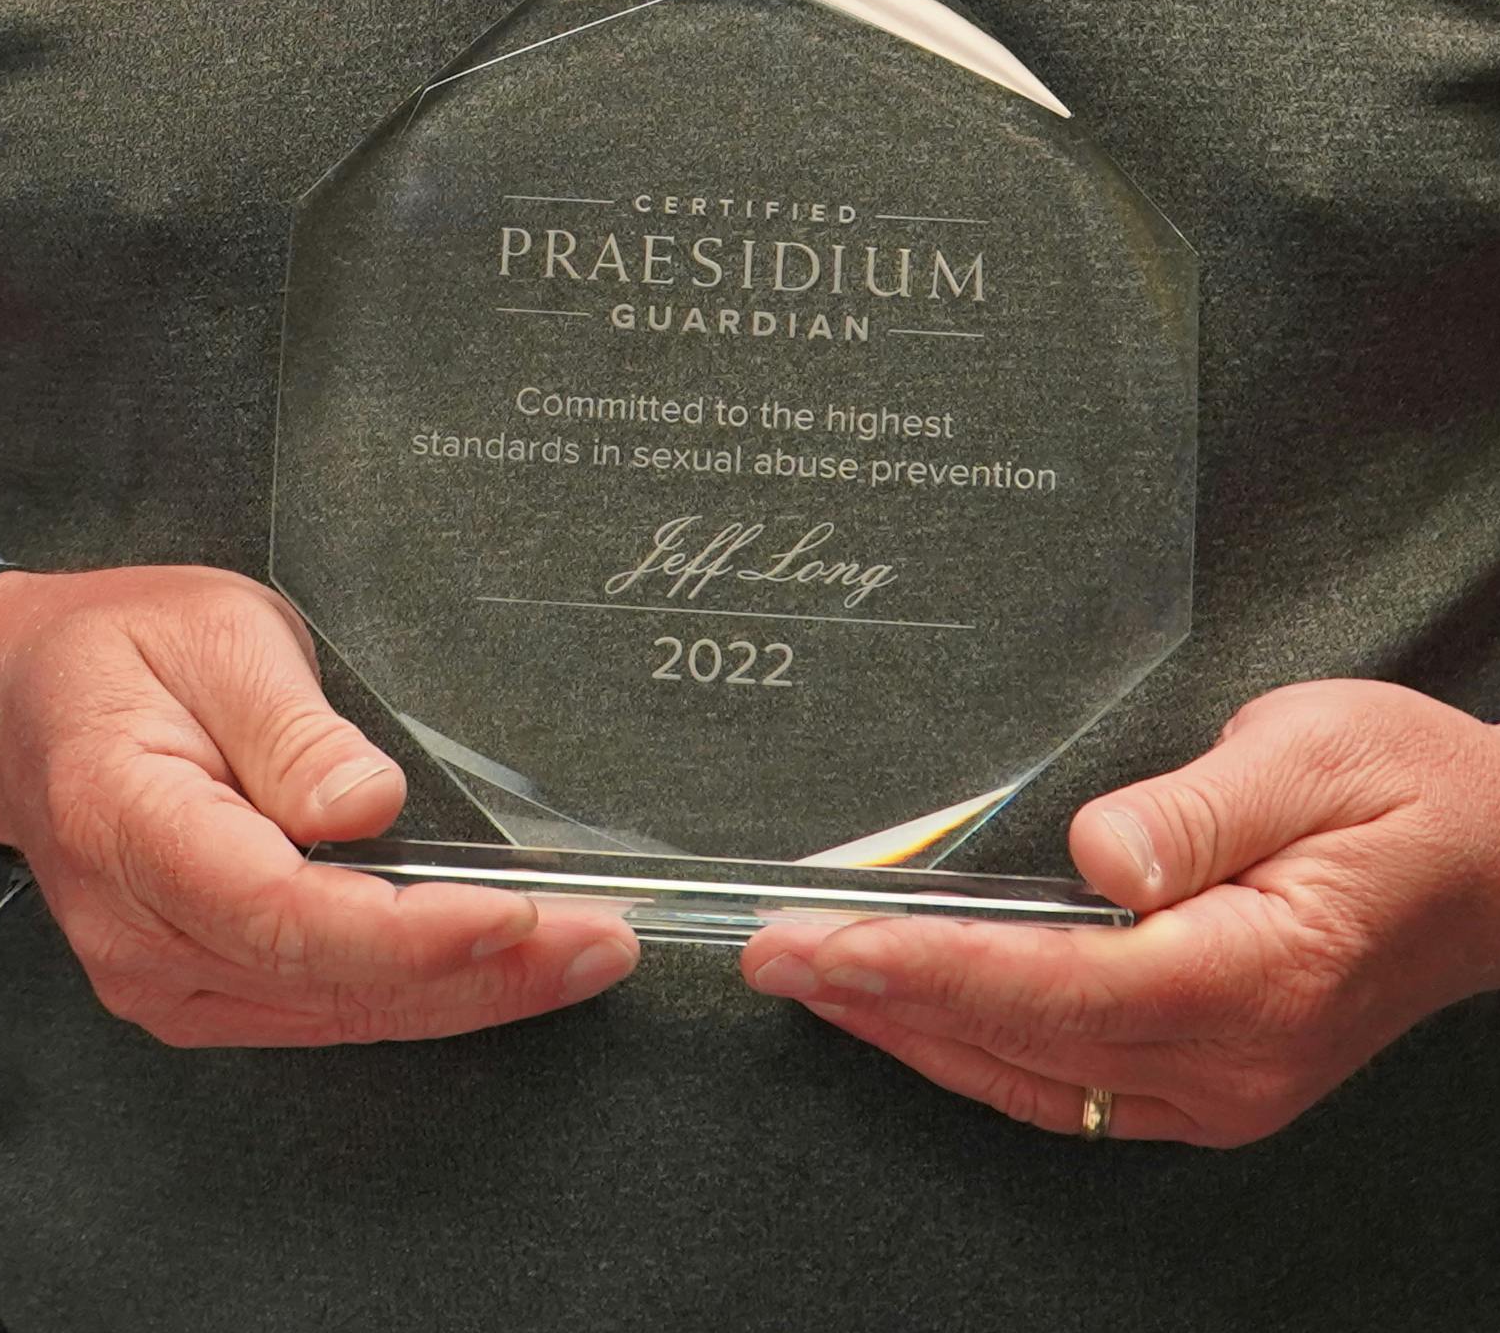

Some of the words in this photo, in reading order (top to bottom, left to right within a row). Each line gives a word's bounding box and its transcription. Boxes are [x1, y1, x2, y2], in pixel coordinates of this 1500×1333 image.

[633, 194, 858, 225] CERTIFIED
[498, 226, 987, 303] PRAESIDIUM
[610, 303, 870, 342] GUARDIAN
[515, 386, 704, 425] Committed
[715, 399, 748, 427] to
[759, 401, 815, 430] the
[827, 404, 955, 441] highest
[411, 430, 581, 464] standards
[592, 438, 621, 466] in
[632, 445, 742, 473] sexual
[753, 448, 860, 480] abuse
[870, 457, 1057, 491] prevention
[604, 515, 765, 600] Jeff
[737, 521, 899, 609] Long
[651, 636, 794, 687] 2022
